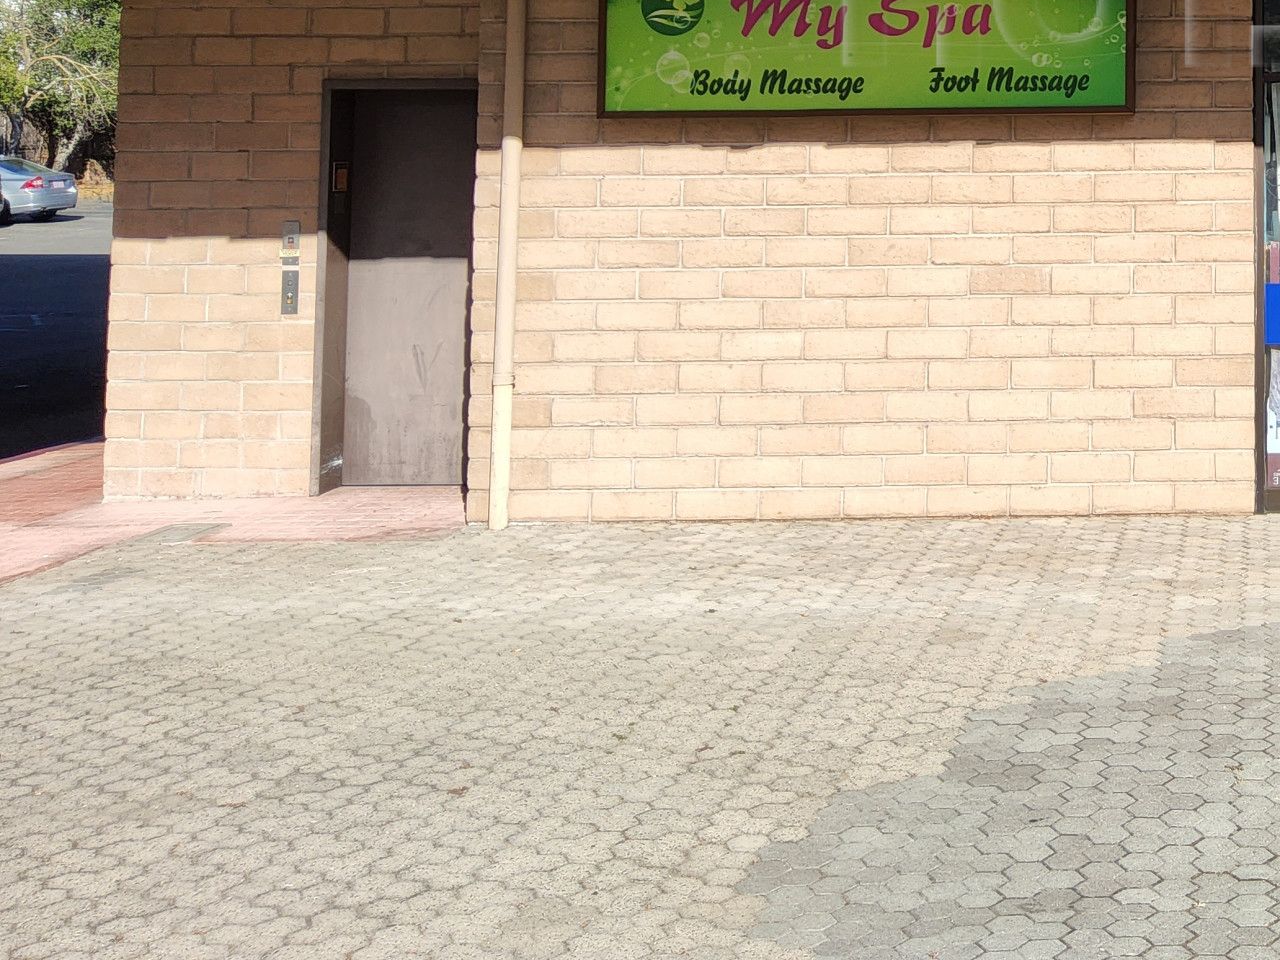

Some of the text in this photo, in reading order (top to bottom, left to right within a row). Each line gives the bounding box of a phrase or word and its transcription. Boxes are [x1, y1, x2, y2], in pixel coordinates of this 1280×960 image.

[689, 69, 865, 102] Body Massage
[929, 66, 1090, 98] Foot Massage
